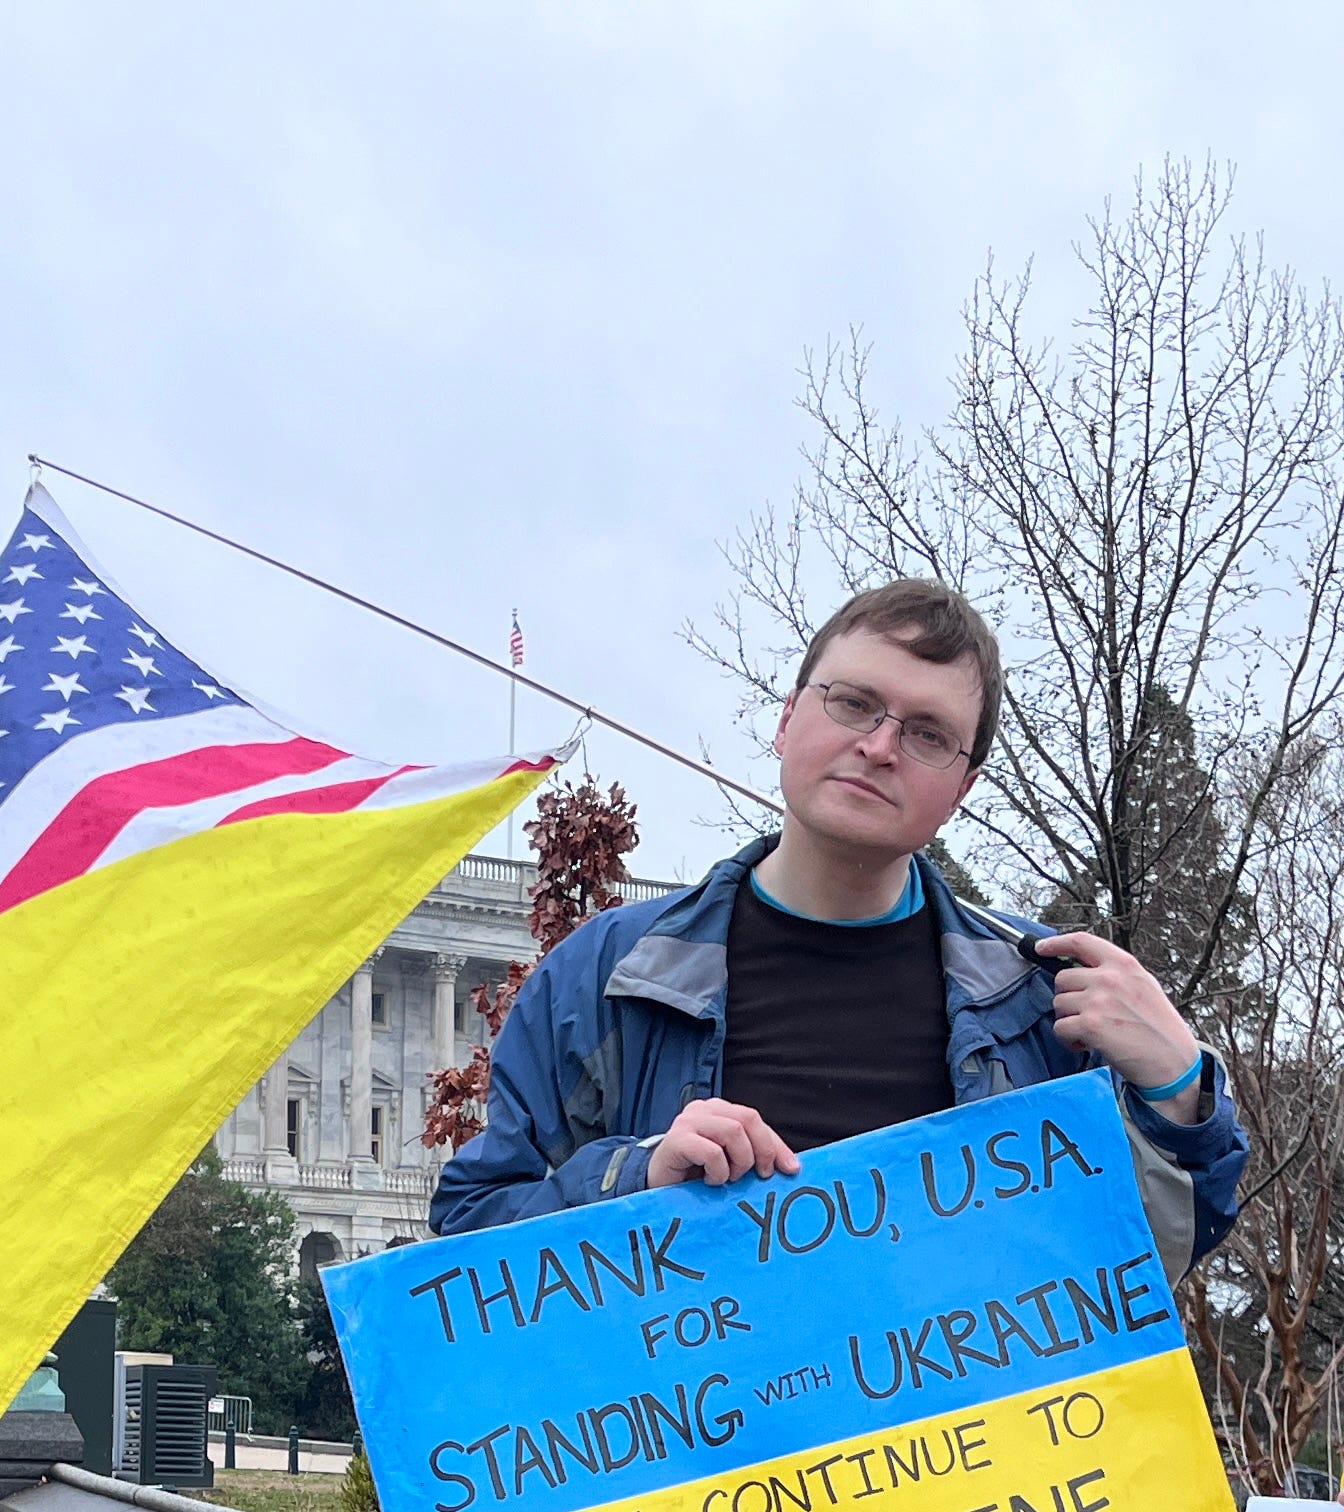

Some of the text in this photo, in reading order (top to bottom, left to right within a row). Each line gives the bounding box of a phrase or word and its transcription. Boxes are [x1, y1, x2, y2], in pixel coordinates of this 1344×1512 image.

[409, 1118, 1105, 1345] THANK YOU, U.S.A.
[428, 1254, 1170, 1512] STANDING WITH UKRAINE
[642, 1295, 751, 1359] FOR
[1027, 1392, 1105, 1446] TO
